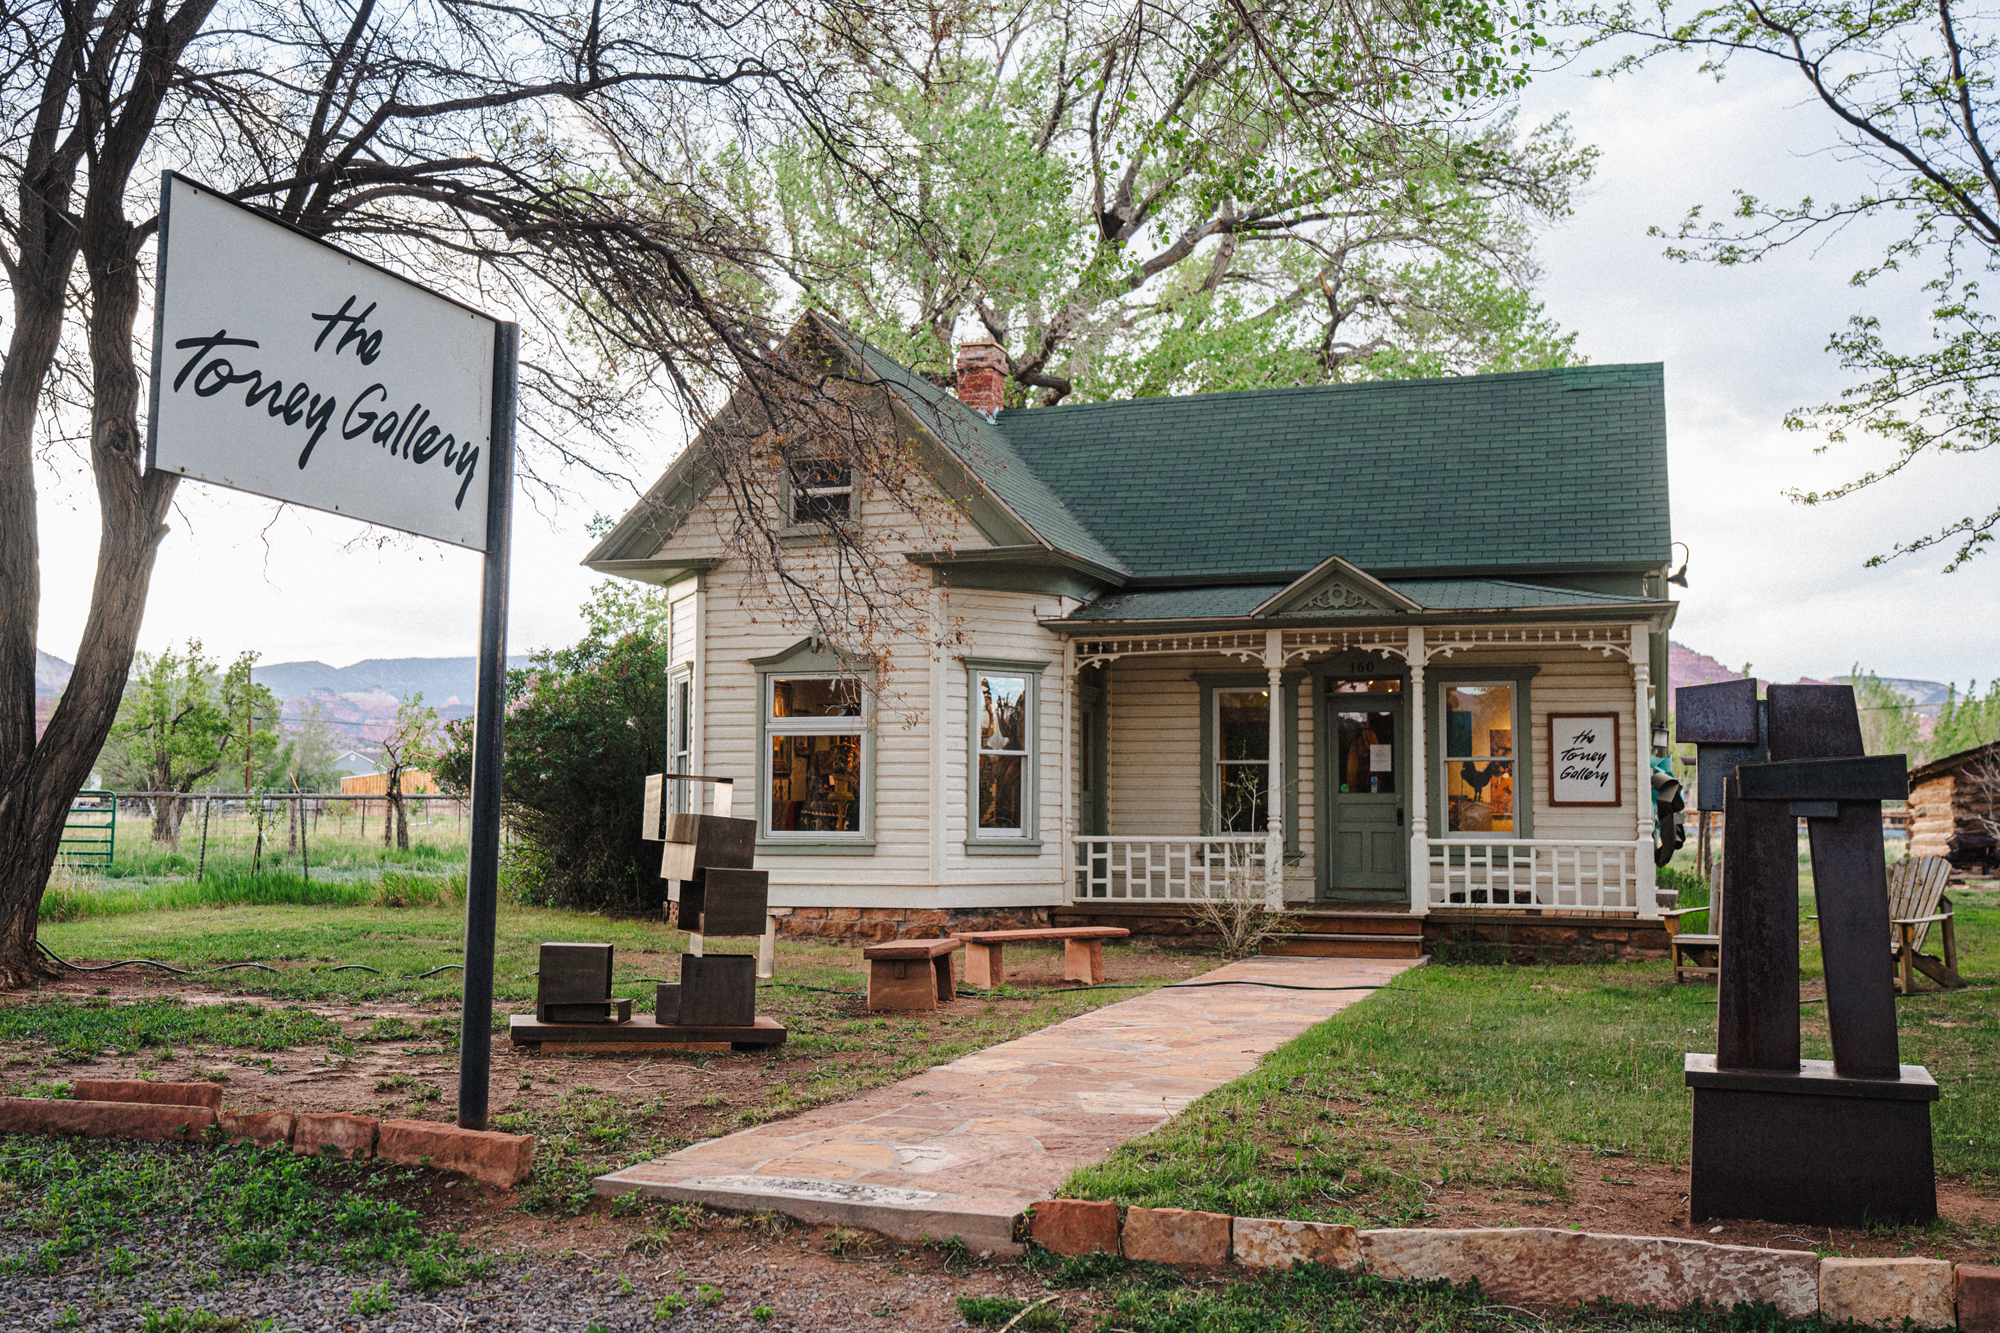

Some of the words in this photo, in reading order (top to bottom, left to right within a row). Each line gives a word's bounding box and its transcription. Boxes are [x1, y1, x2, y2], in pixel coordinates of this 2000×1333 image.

[312, 294, 383, 366] the
[342, 383, 480, 511] Gallery
[1350, 661, 1375, 673] 160
[1560, 765, 1609, 788] Gallery
